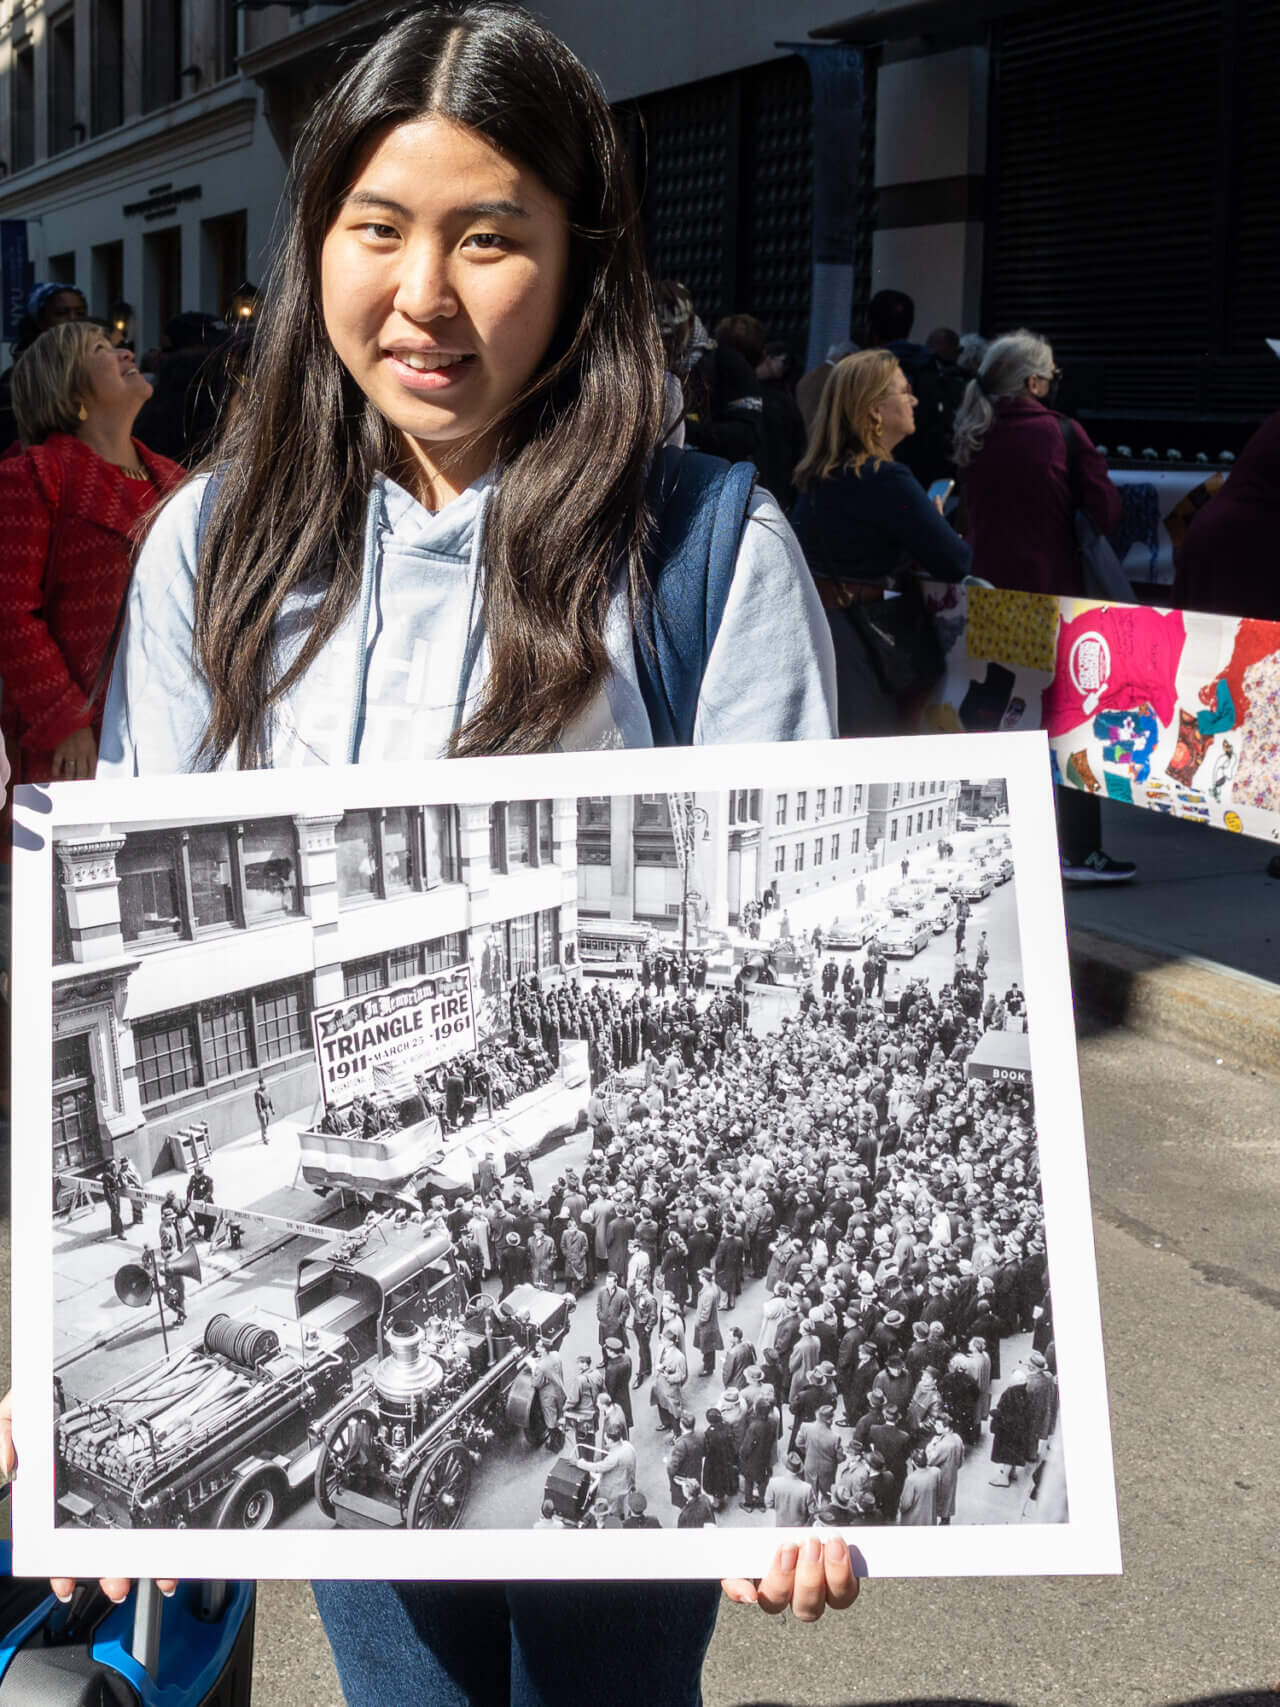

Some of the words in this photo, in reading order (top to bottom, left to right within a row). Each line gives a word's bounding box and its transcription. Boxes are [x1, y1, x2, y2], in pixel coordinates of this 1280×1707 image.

[364, 1000, 379, 1019] In
[322, 1011, 423, 1062] TRIANGLE
[430, 994, 468, 1024] FIRE
[992, 1068, 1026, 1081] BOOK
